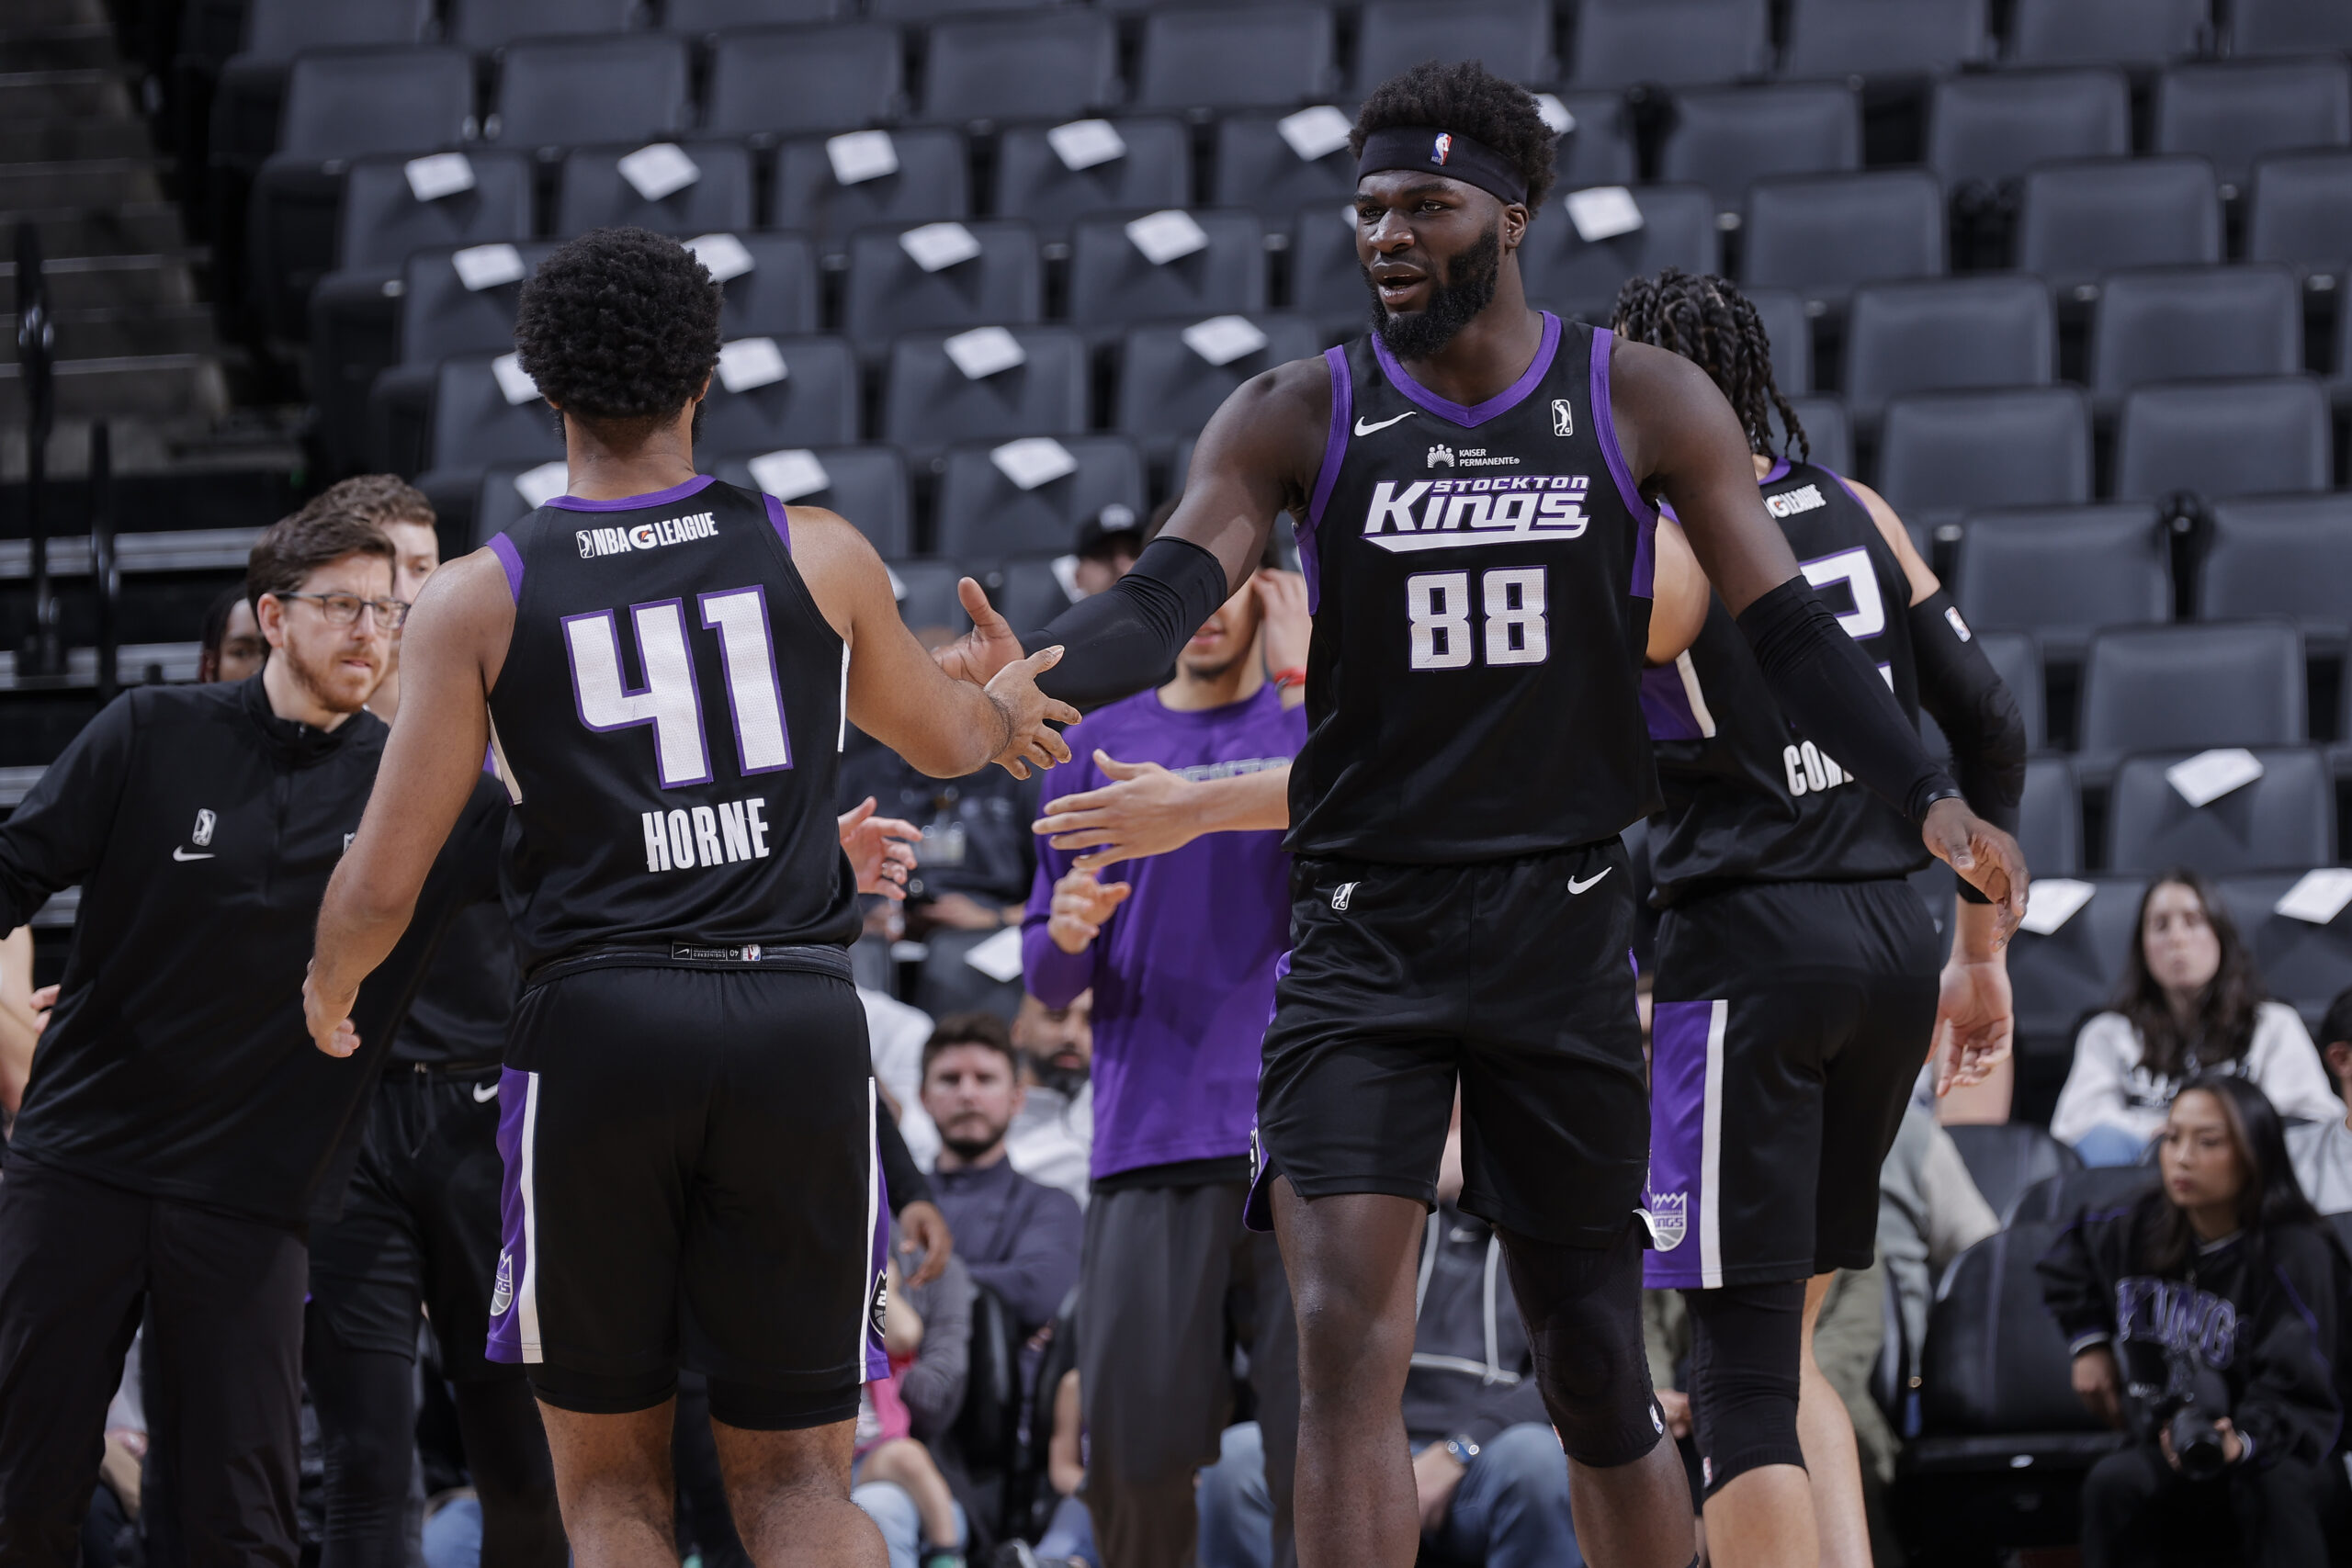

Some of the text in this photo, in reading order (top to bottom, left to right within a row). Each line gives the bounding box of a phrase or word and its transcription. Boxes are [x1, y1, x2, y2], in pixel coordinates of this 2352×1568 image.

[1459, 448, 1487, 457] KAISER
[1431, 475, 1590, 493] STOCKTON
[591, 512, 718, 556] NBA G LEAGUE
[1360, 479, 1590, 552] Kings
[1405, 564, 1550, 671] 88
[560, 583, 794, 791] 41
[641, 798, 770, 873] HORNE
[729, 949, 740, 957] 40
